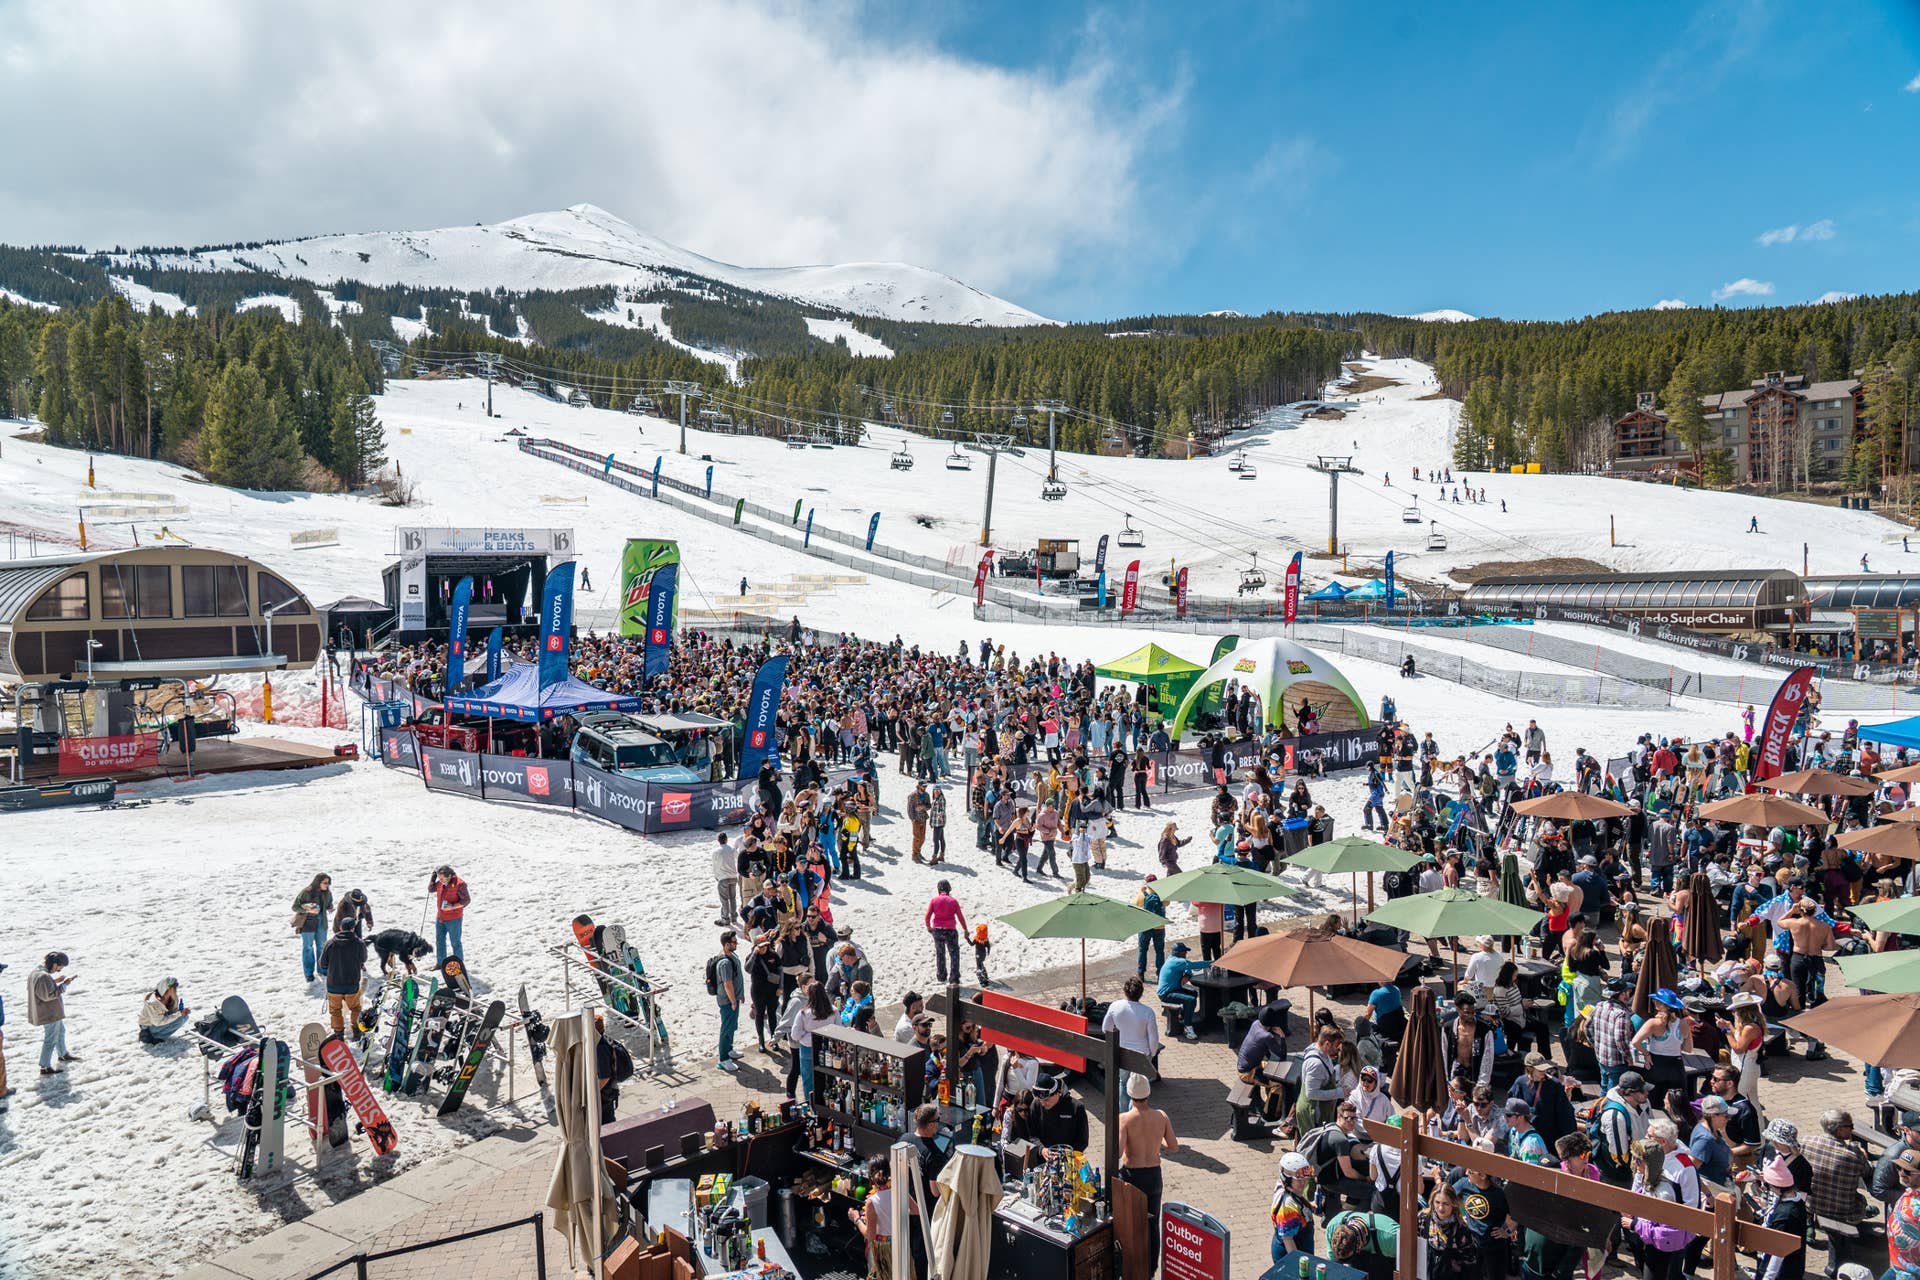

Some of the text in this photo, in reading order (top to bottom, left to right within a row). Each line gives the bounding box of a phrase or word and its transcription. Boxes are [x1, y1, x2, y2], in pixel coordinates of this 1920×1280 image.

[484, 532, 525, 541] PEAKS
[484, 542, 535, 551] & BEATS
[656, 591, 667, 626] TOYOTA
[1124, 583, 1134, 609] TOYOTA
[1288, 588, 1296, 617] TOYOTA
[456, 605, 465, 638] TOYOTA
[552, 594, 562, 632] TOYOTA
[1671, 612, 1746, 625] SuperChair
[1769, 653, 1794, 666] HIGH
[758, 688, 772, 728] TOYOTA
[1160, 692, 1177, 706] DEW
[80, 742, 138, 760] CLOSED
[1764, 710, 1791, 767] BRECK
[1159, 761, 1209, 781] TOYOTA
[1239, 755, 1262, 769] BRECK
[326, 1044, 381, 1126] SALOMON
[1166, 1220, 1204, 1246] Outbar
[1166, 1236, 1202, 1263] Closed
